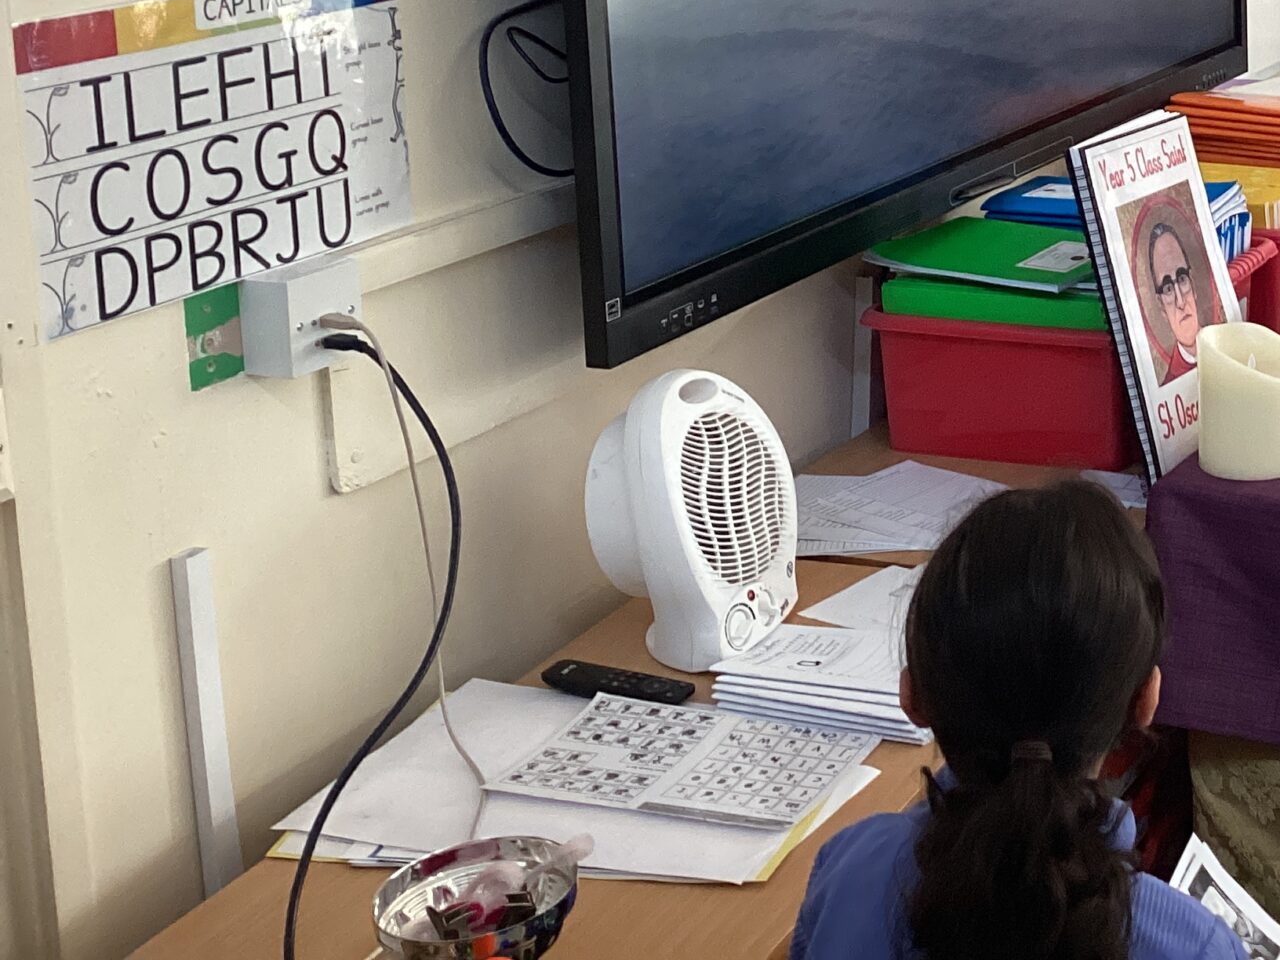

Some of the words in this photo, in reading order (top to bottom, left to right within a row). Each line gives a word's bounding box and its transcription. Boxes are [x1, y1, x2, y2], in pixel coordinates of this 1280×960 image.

[1098, 159, 1125, 191] Year
[1126, 152, 1136, 183] 5
[1136, 147, 1162, 178] Class
[1161, 135, 1187, 170] Saint
[1157, 401, 1176, 439] St
[1176, 393, 1198, 431] Osc
